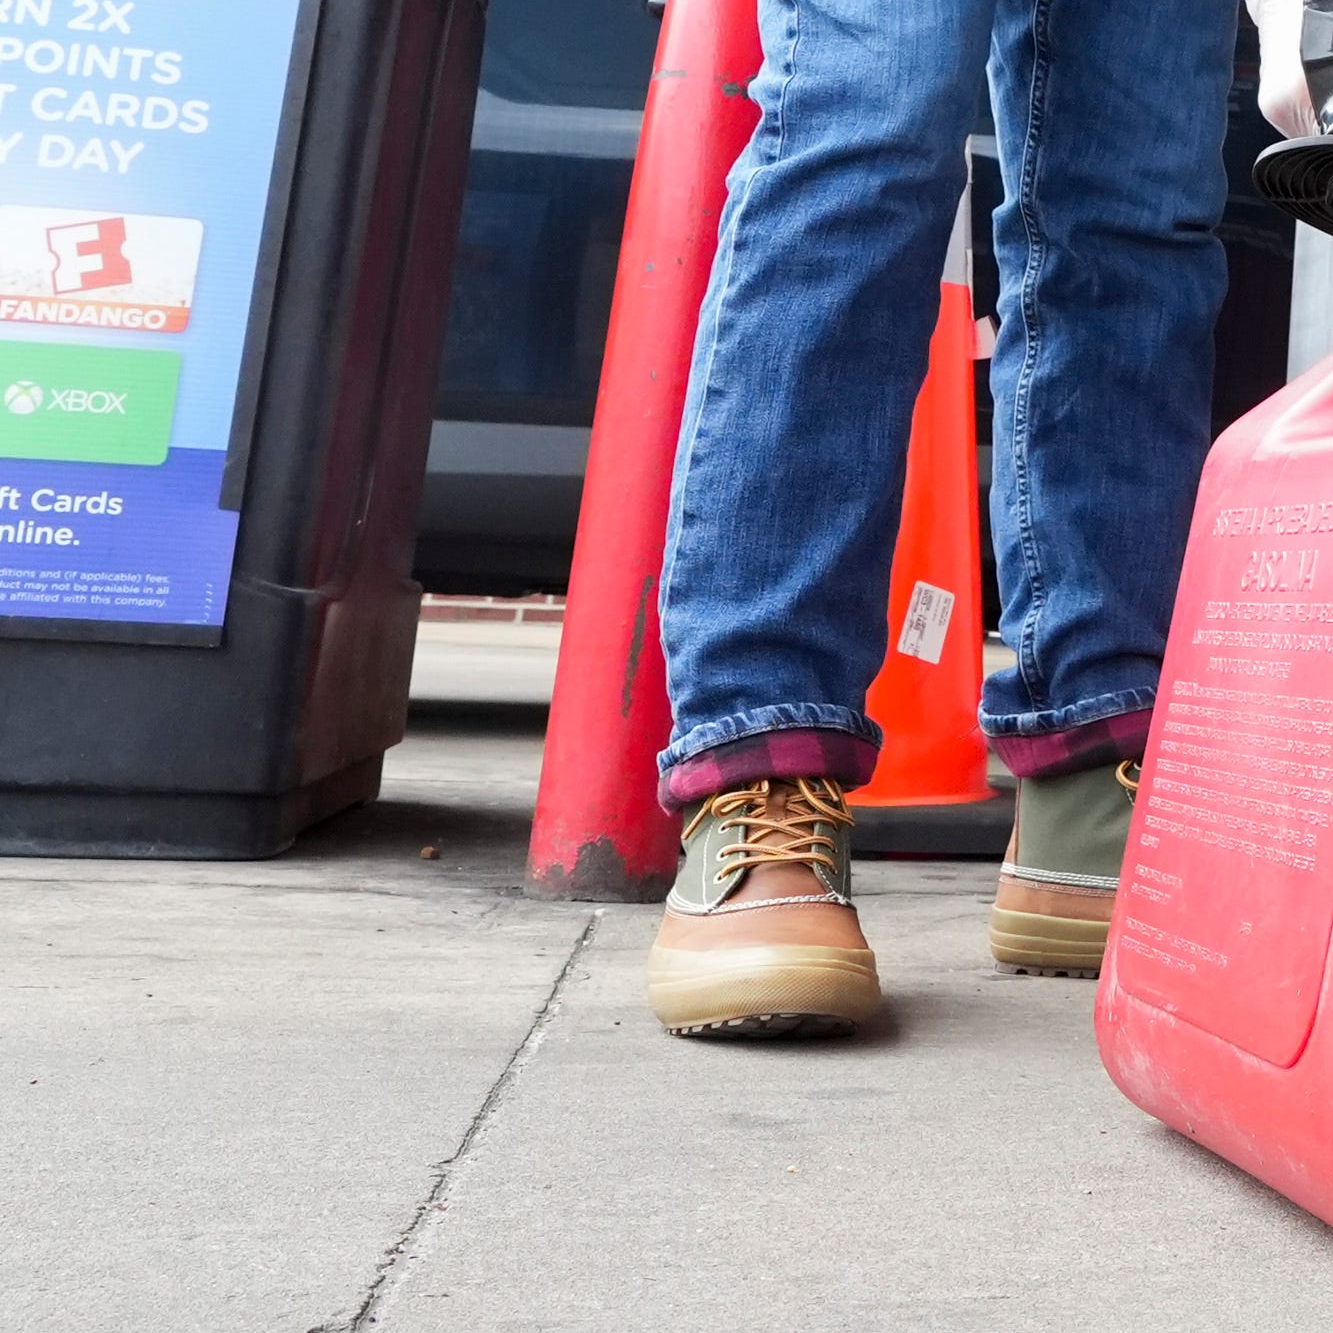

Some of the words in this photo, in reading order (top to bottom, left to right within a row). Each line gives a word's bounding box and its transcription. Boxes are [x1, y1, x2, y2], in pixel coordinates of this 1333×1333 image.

[0, 37, 183, 85] POINTS
[31, 87, 210, 134] CARDS
[37, 134, 145, 174] DAY
[0, 299, 167, 330] FANDANGO
[47, 388, 128, 414] XBOX
[31, 489, 123, 515] Cards
[0, 520, 80, 546] nline.
[23, 582, 47, 593] may
[51, 582, 70, 592] not
[73, 583, 88, 592] be
[90, 583, 140, 594] available
[143, 585, 153, 594] in
[155, 585, 169, 595] all
[39, 570, 61, 580] and
[80, 571, 142, 584] applicable)
[9, 592, 59, 603] affiliated
[63, 594, 87, 604] with
[90, 595, 110, 604] this
